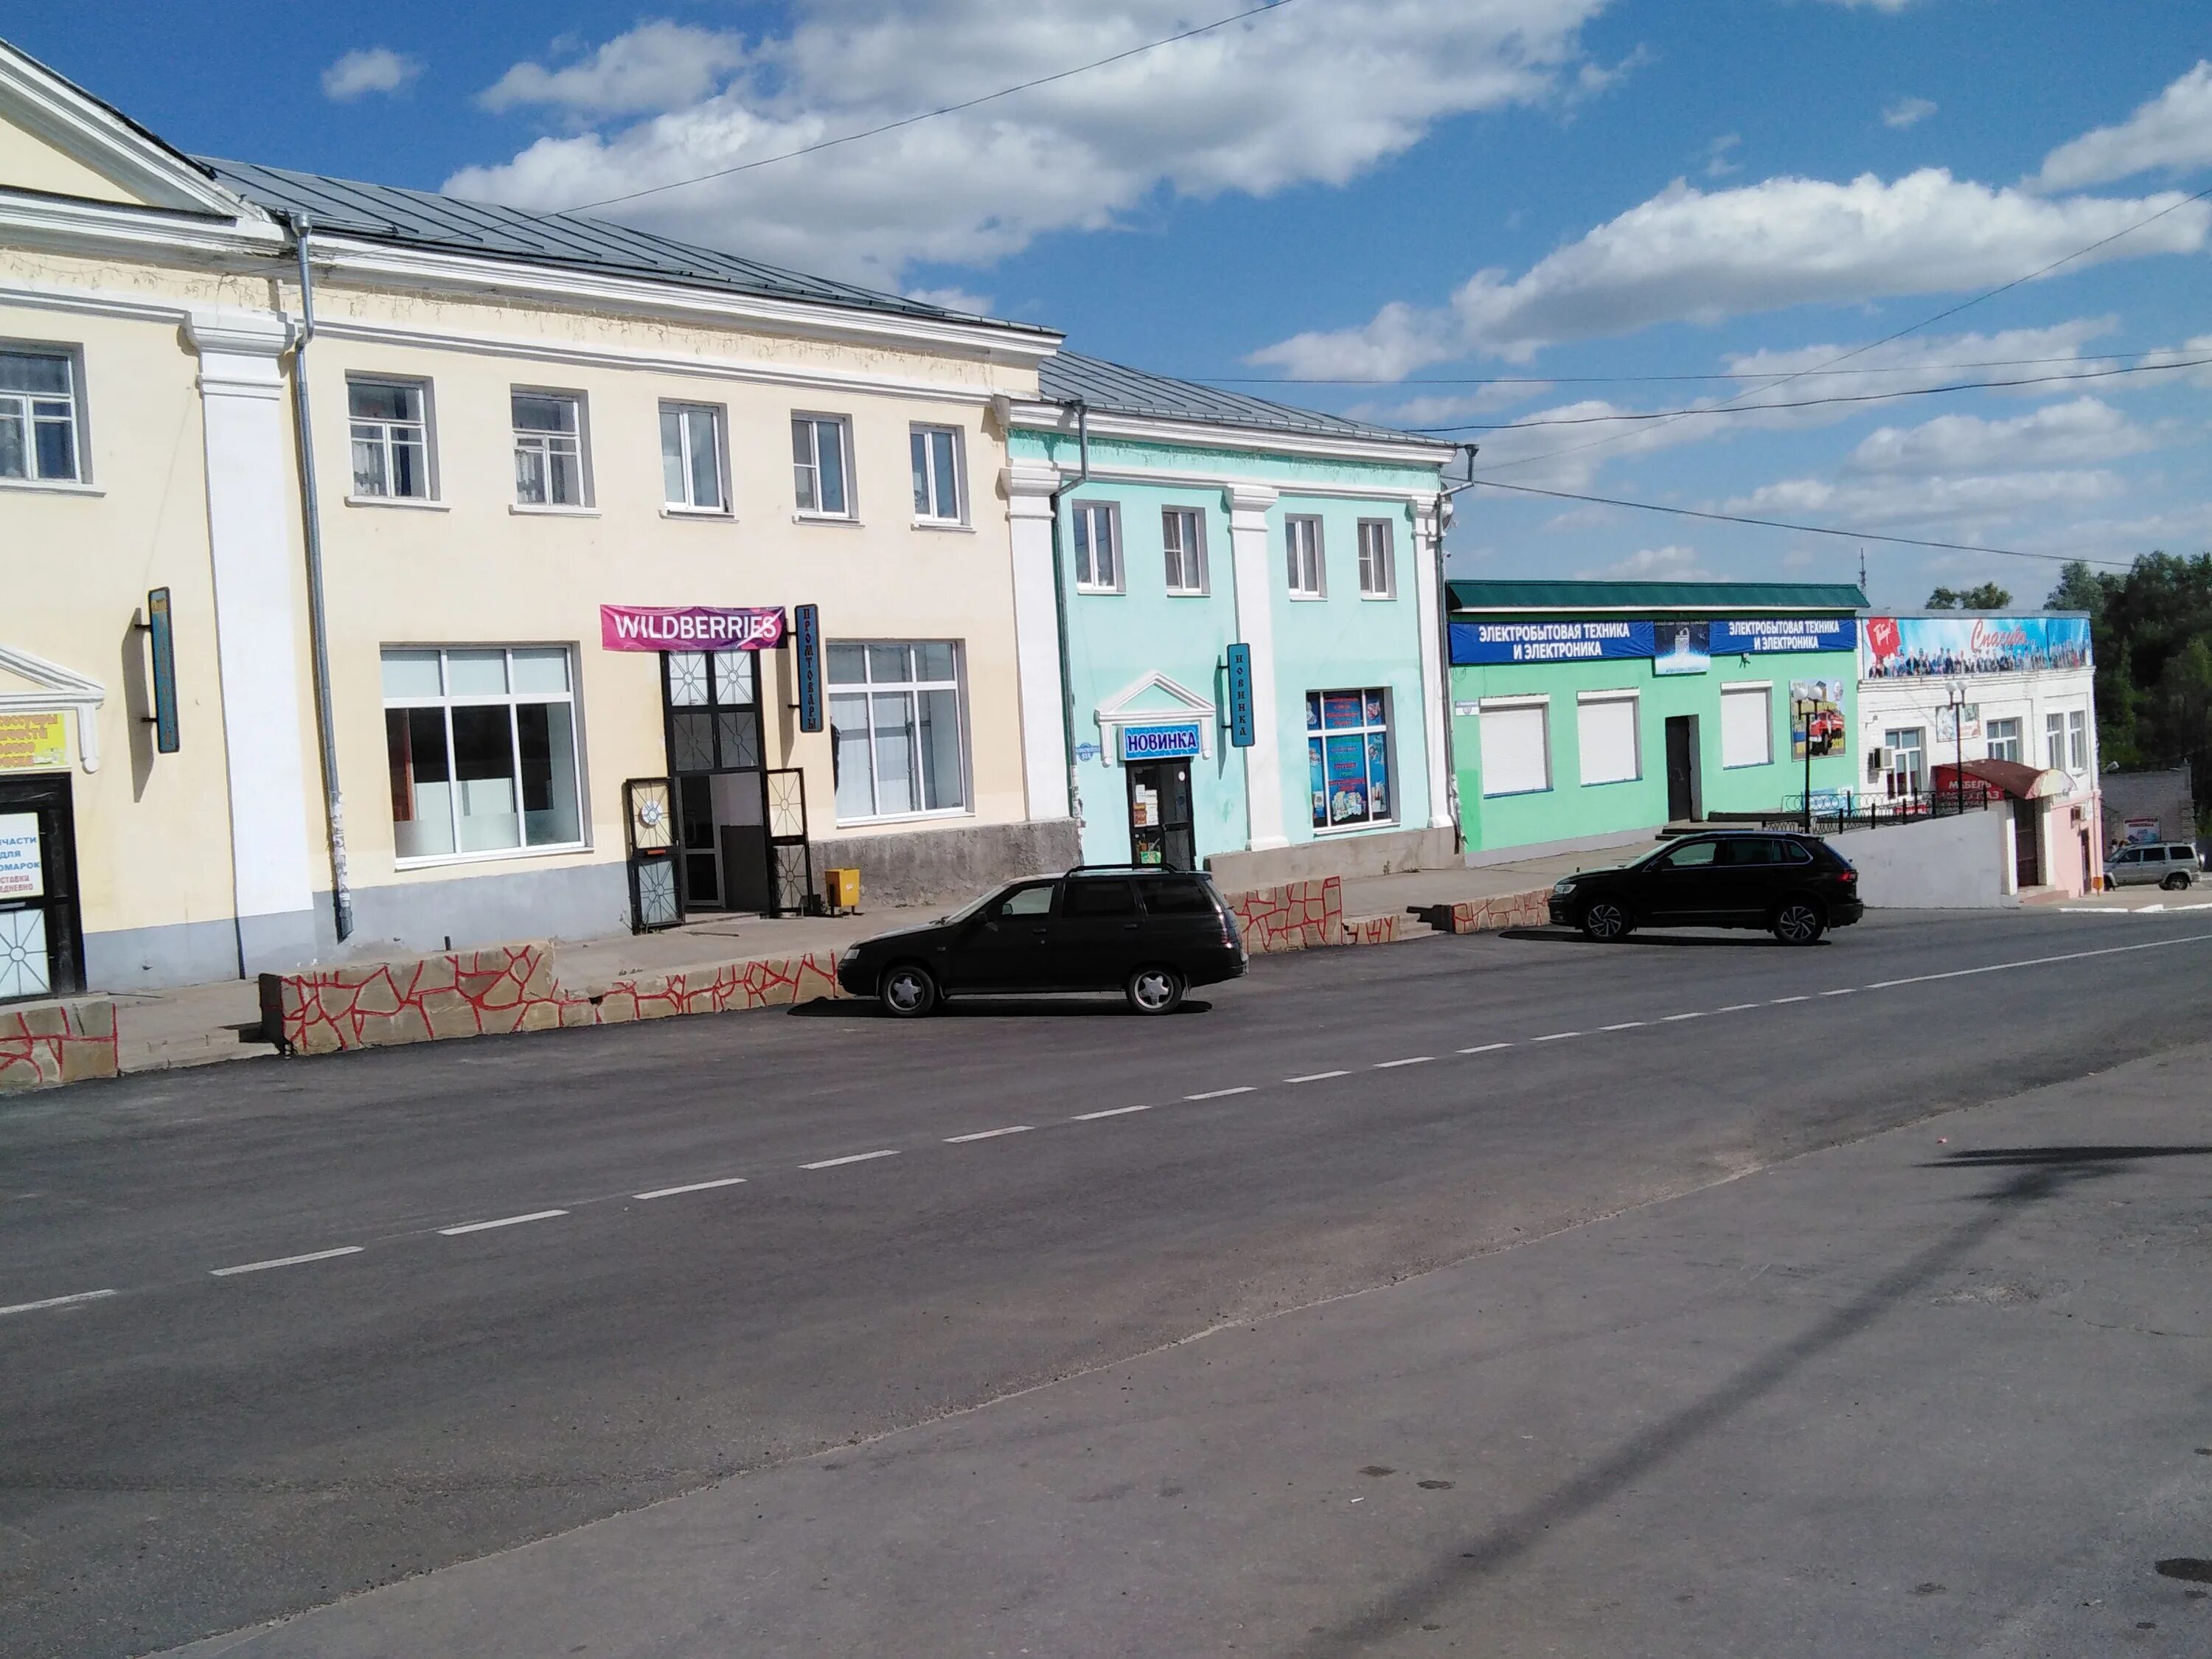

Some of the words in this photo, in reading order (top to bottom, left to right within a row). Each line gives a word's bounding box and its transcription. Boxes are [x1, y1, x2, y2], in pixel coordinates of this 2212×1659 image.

[613, 615, 776, 639] WILDBERRIES
[1479, 625, 1582, 642] ЭЛЕКТРОБЫТОВАЯ
[1584, 623, 1630, 639] ТЕХНИКА
[1728, 622, 1805, 636] ЭЛЕКТРОБЫТОВАЯ
[1806, 621, 1840, 633] ТЕХНИКА
[1513, 644, 1522, 660] И
[1524, 641, 1602, 660] ЭЛЕКТРОНИКА
[1753, 637, 1761, 650] И
[1761, 636, 1819, 650] ЭЛЕКТРОНИКА
[802, 608, 816, 729] ПРОМТОВАРЫ
[1235, 655, 1247, 736] НОВИНКА
[1127, 731, 1197, 752] НОВИНКА
[0, 837, 37, 846] ЧАСТИ
[0, 850, 21, 860] ДЛЯ
